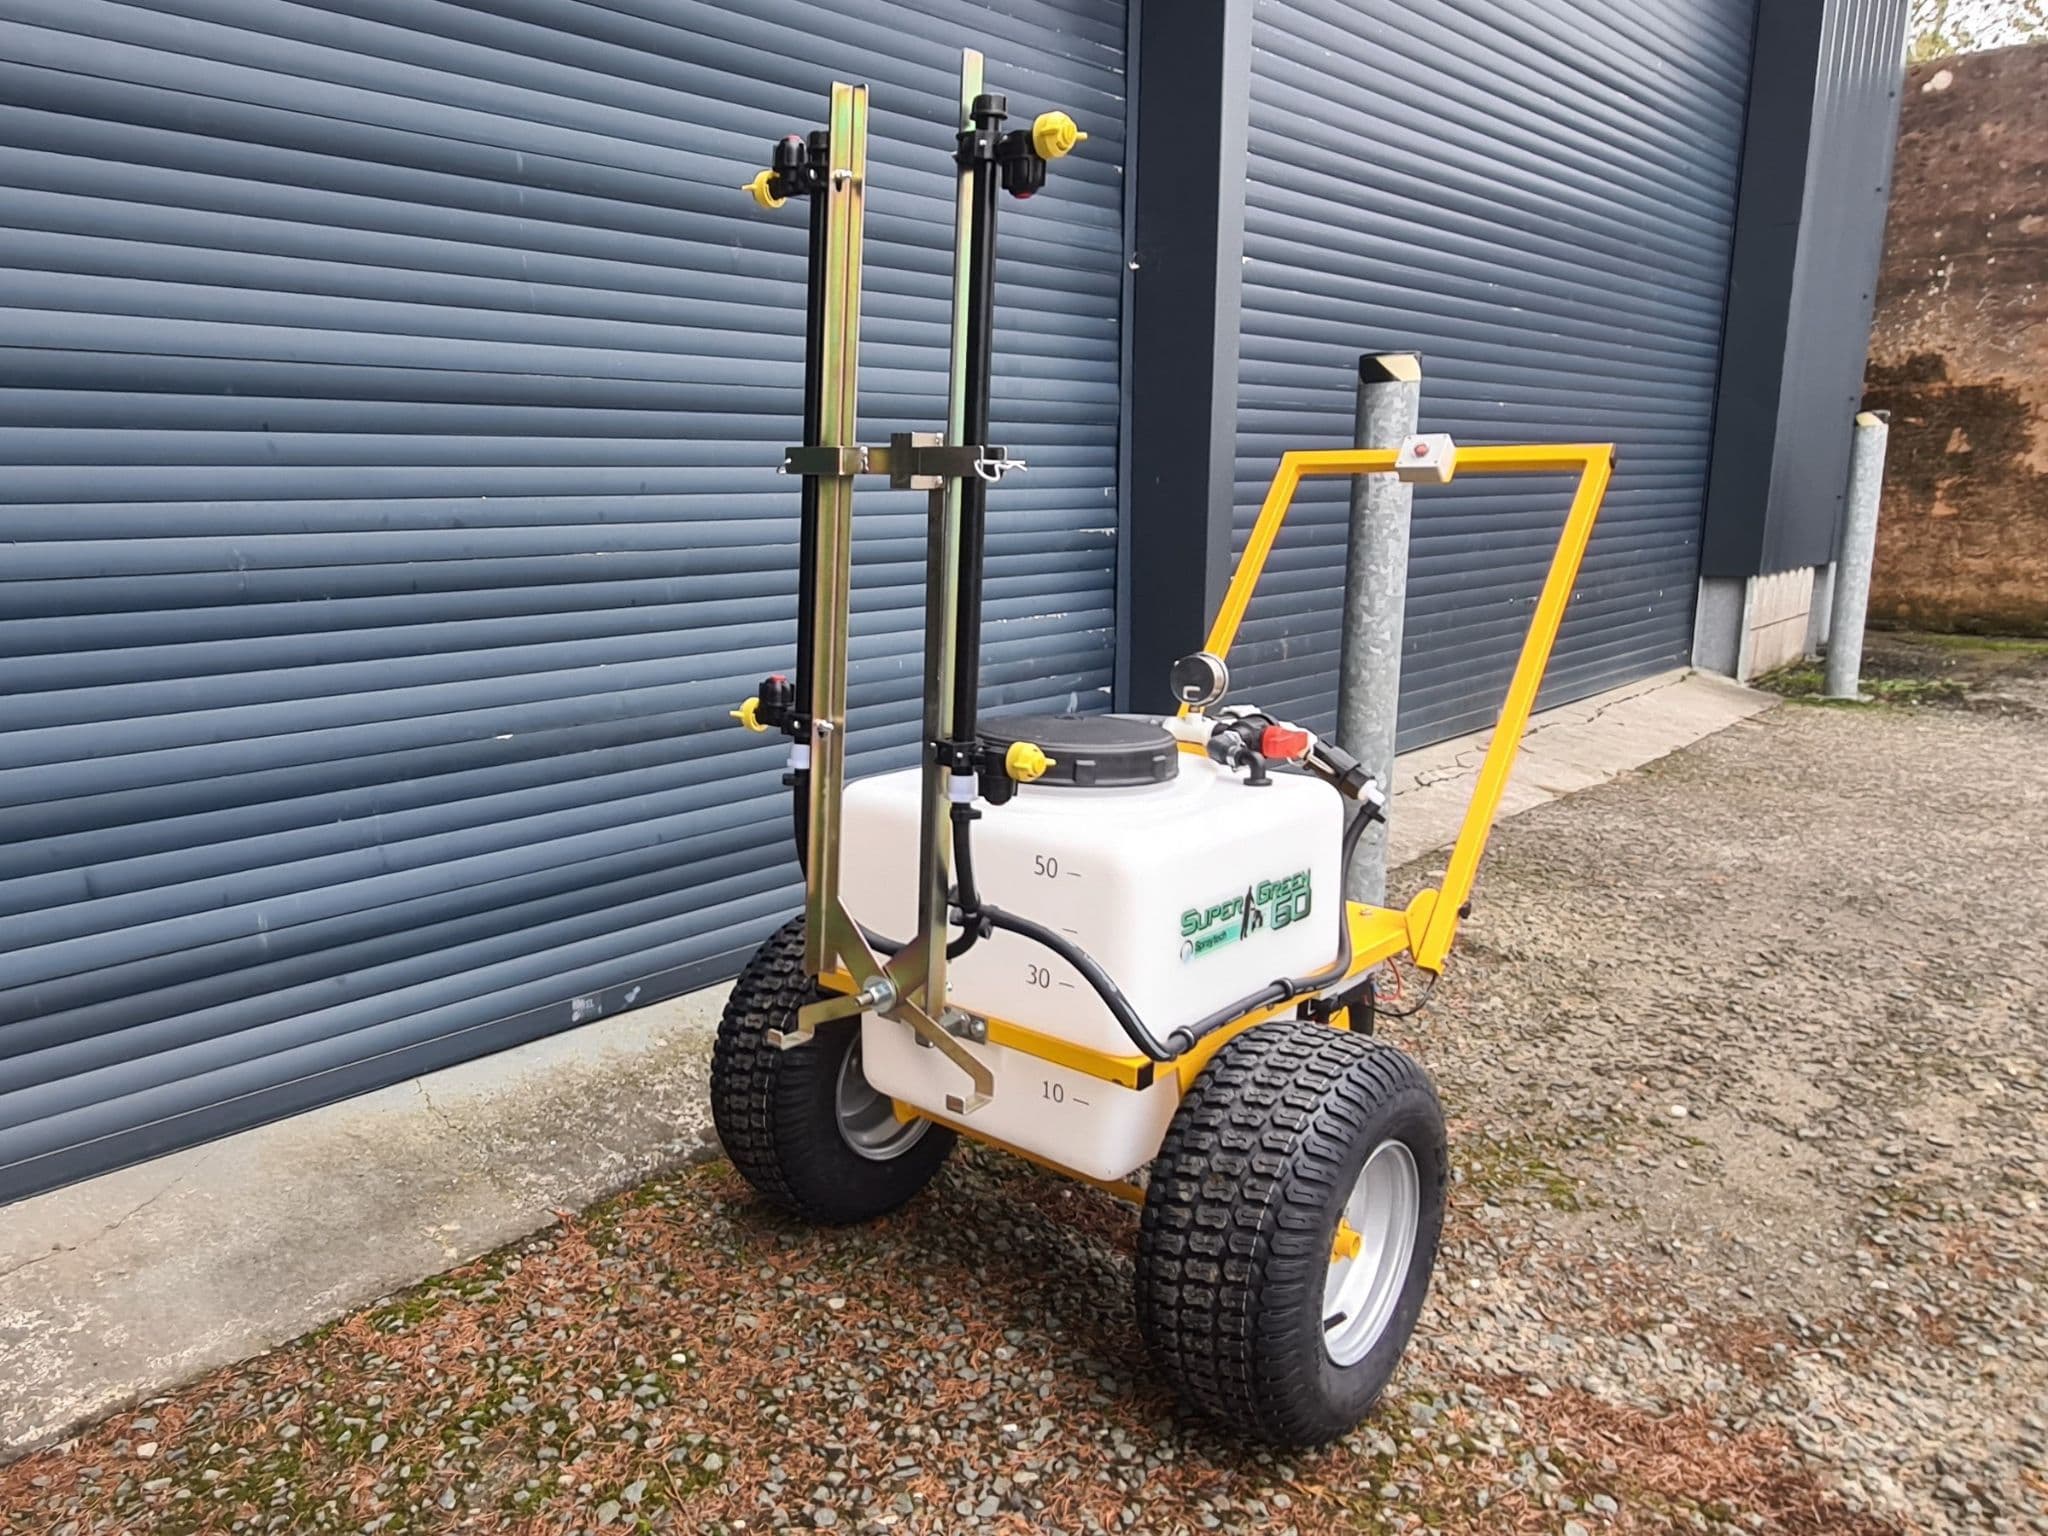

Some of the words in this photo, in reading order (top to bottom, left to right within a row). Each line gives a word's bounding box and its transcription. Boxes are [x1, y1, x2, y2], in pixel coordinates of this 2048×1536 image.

[1034, 855, 1058, 878] 50
[1181, 895, 1244, 937] SUPER
[1271, 887, 1312, 931] 60
[1026, 964, 1050, 989] 30
[1042, 1080, 1064, 1103] 10
